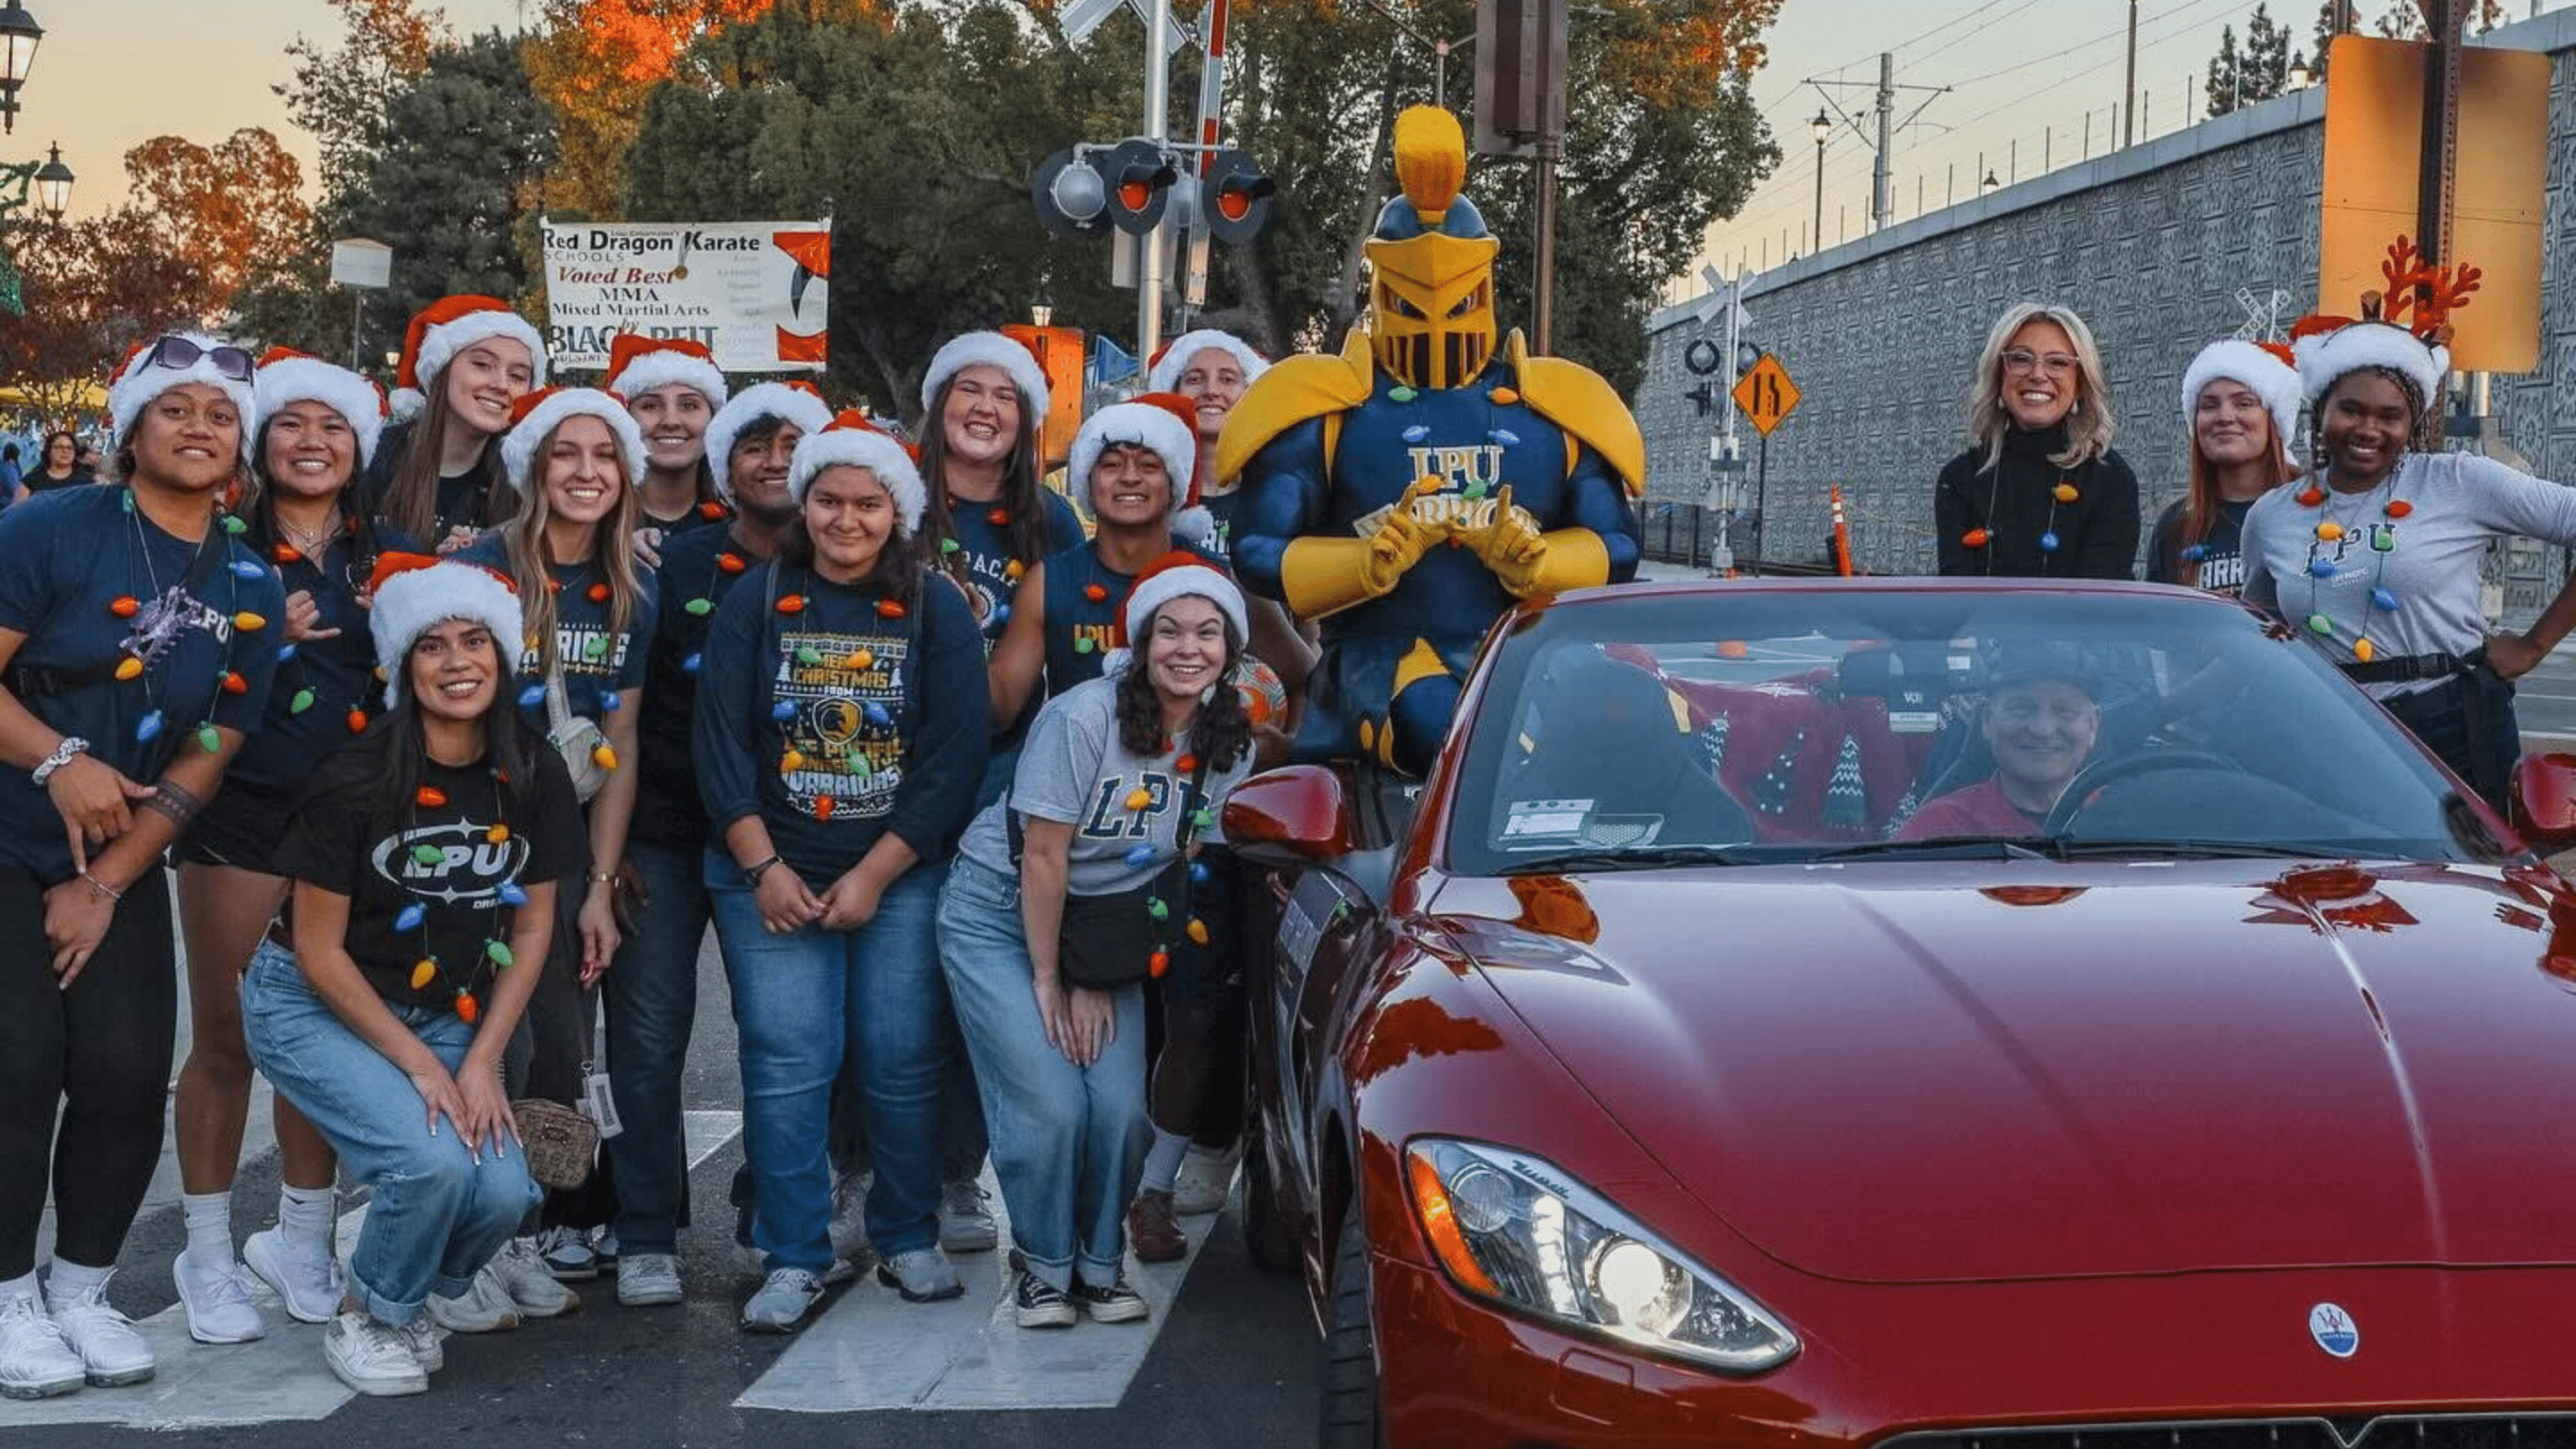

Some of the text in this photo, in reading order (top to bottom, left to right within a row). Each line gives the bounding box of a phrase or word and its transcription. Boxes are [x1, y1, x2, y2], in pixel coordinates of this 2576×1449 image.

[541, 228, 760, 255] Red Dragon Karate
[544, 250, 625, 263] SCHOOLS
[559, 267, 676, 284] Voted Best
[599, 287, 660, 301] MMA
[552, 302, 710, 316] Mixed Martial Arts
[549, 325, 623, 353] BLAC
